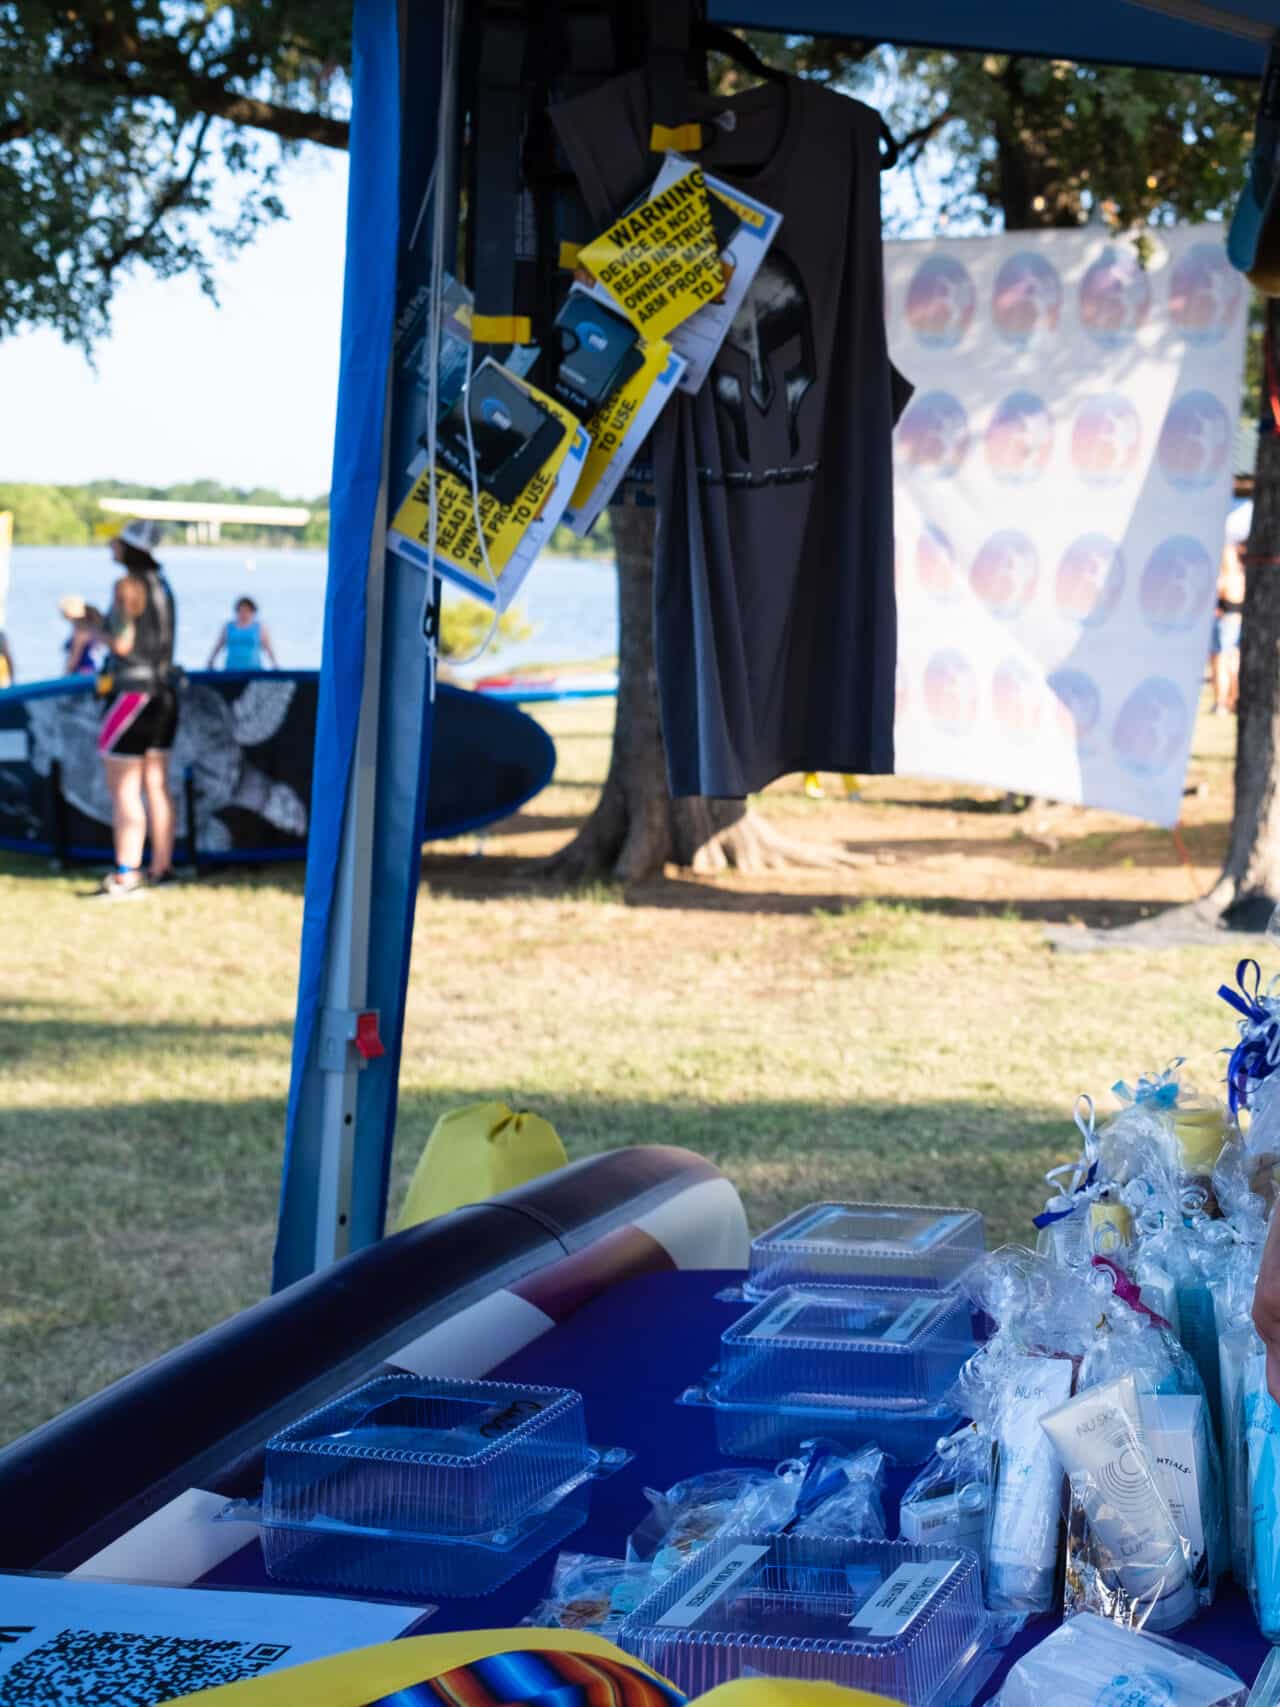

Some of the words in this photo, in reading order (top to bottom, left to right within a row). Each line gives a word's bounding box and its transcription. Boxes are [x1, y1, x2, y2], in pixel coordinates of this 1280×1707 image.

[606, 168, 704, 248] WARNING
[599, 239, 650, 283] DEVICE
[650, 226, 668, 243] IS
[666, 202, 696, 230] NOT
[613, 263, 652, 295] READ
[651, 213, 711, 266] INSTRUC
[623, 259, 683, 309] OWNERS
[690, 280, 714, 301] TO
[636, 292, 670, 323] ARM
[436, 509, 468, 550] READ
[488, 503, 514, 534] PRO
[513, 504, 532, 526] TO
